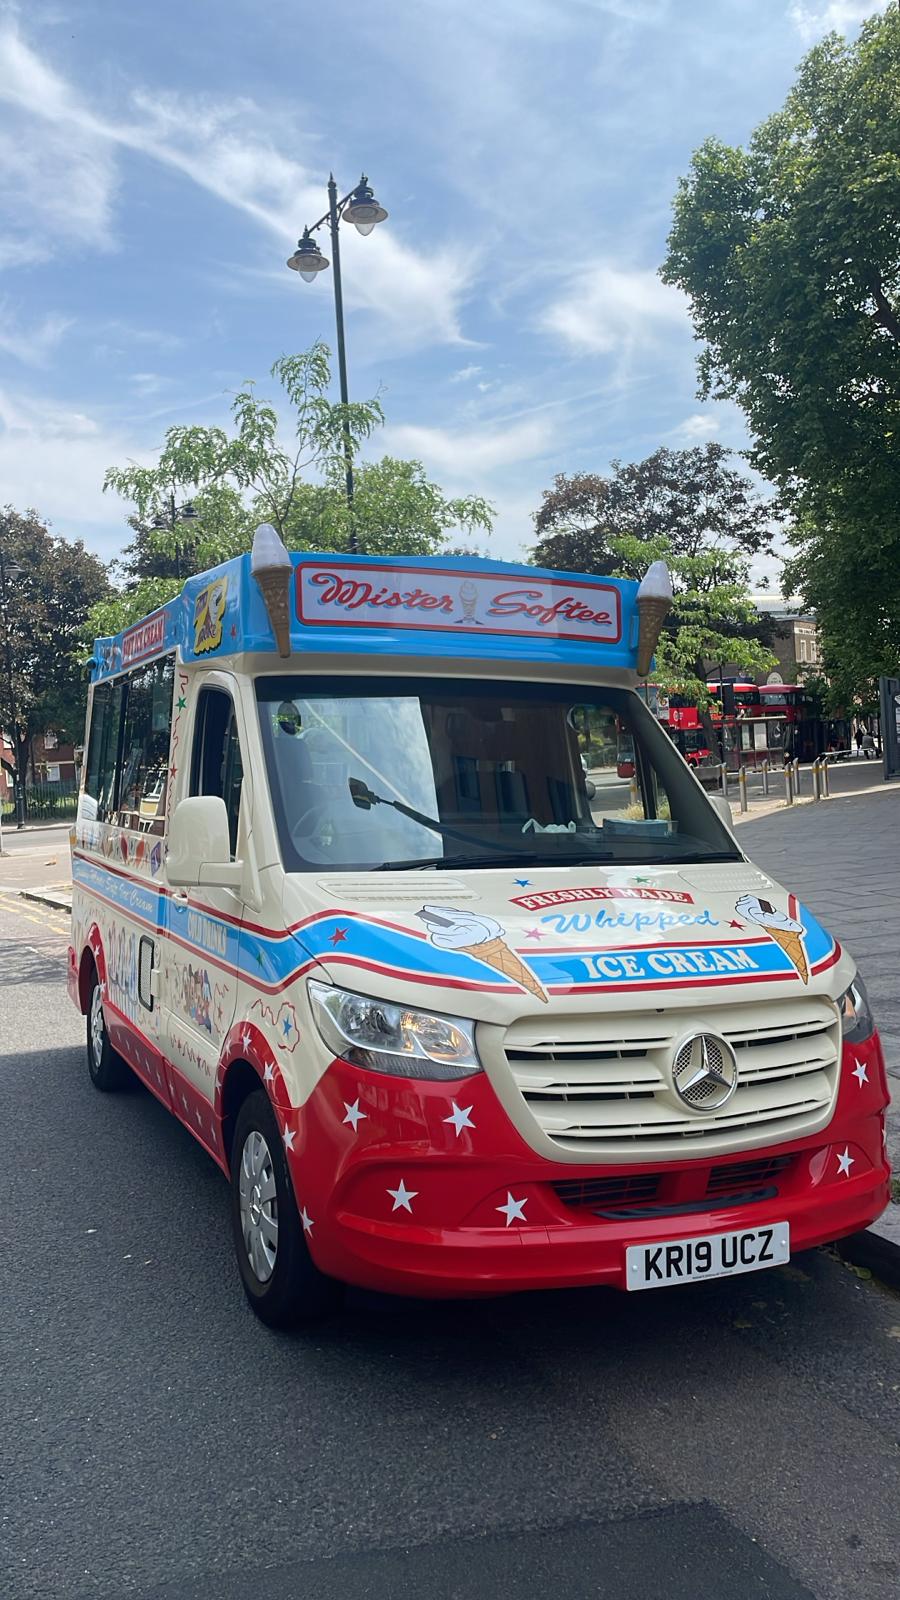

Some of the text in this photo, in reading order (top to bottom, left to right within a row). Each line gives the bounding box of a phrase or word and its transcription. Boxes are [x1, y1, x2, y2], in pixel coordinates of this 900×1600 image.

[309, 572, 612, 625] Mister Softee
[519, 887, 688, 910] FRESHLY MADE
[540, 909, 720, 933] Whipped
[581, 949, 760, 980] ICE CREAM
[644, 1229, 774, 1281] KR19 UCZ
